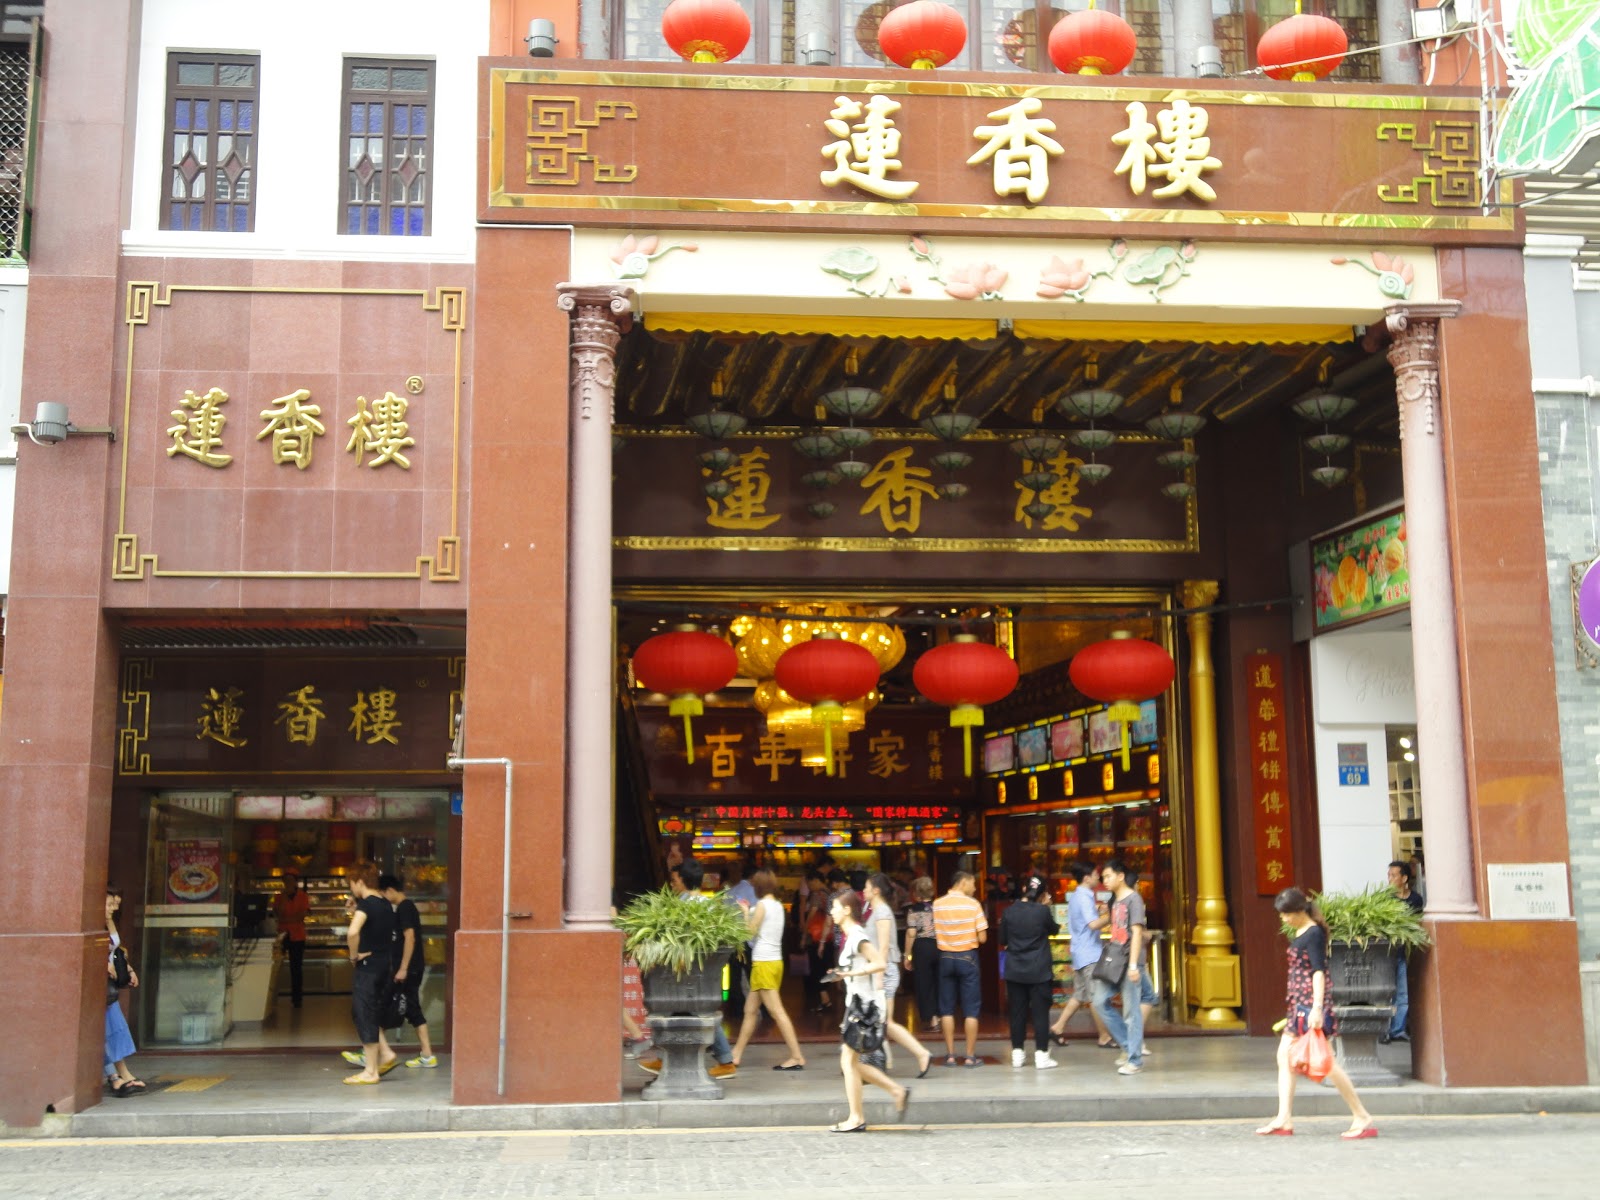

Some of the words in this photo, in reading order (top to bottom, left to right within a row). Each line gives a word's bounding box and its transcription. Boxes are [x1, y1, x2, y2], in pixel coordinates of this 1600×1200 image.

[820, 94, 1223, 203] 蓮香樓
[166, 387, 415, 470] 蓮香樓
[195, 684, 403, 748] 蓮香樓
[1346, 772, 1362, 785] 69
